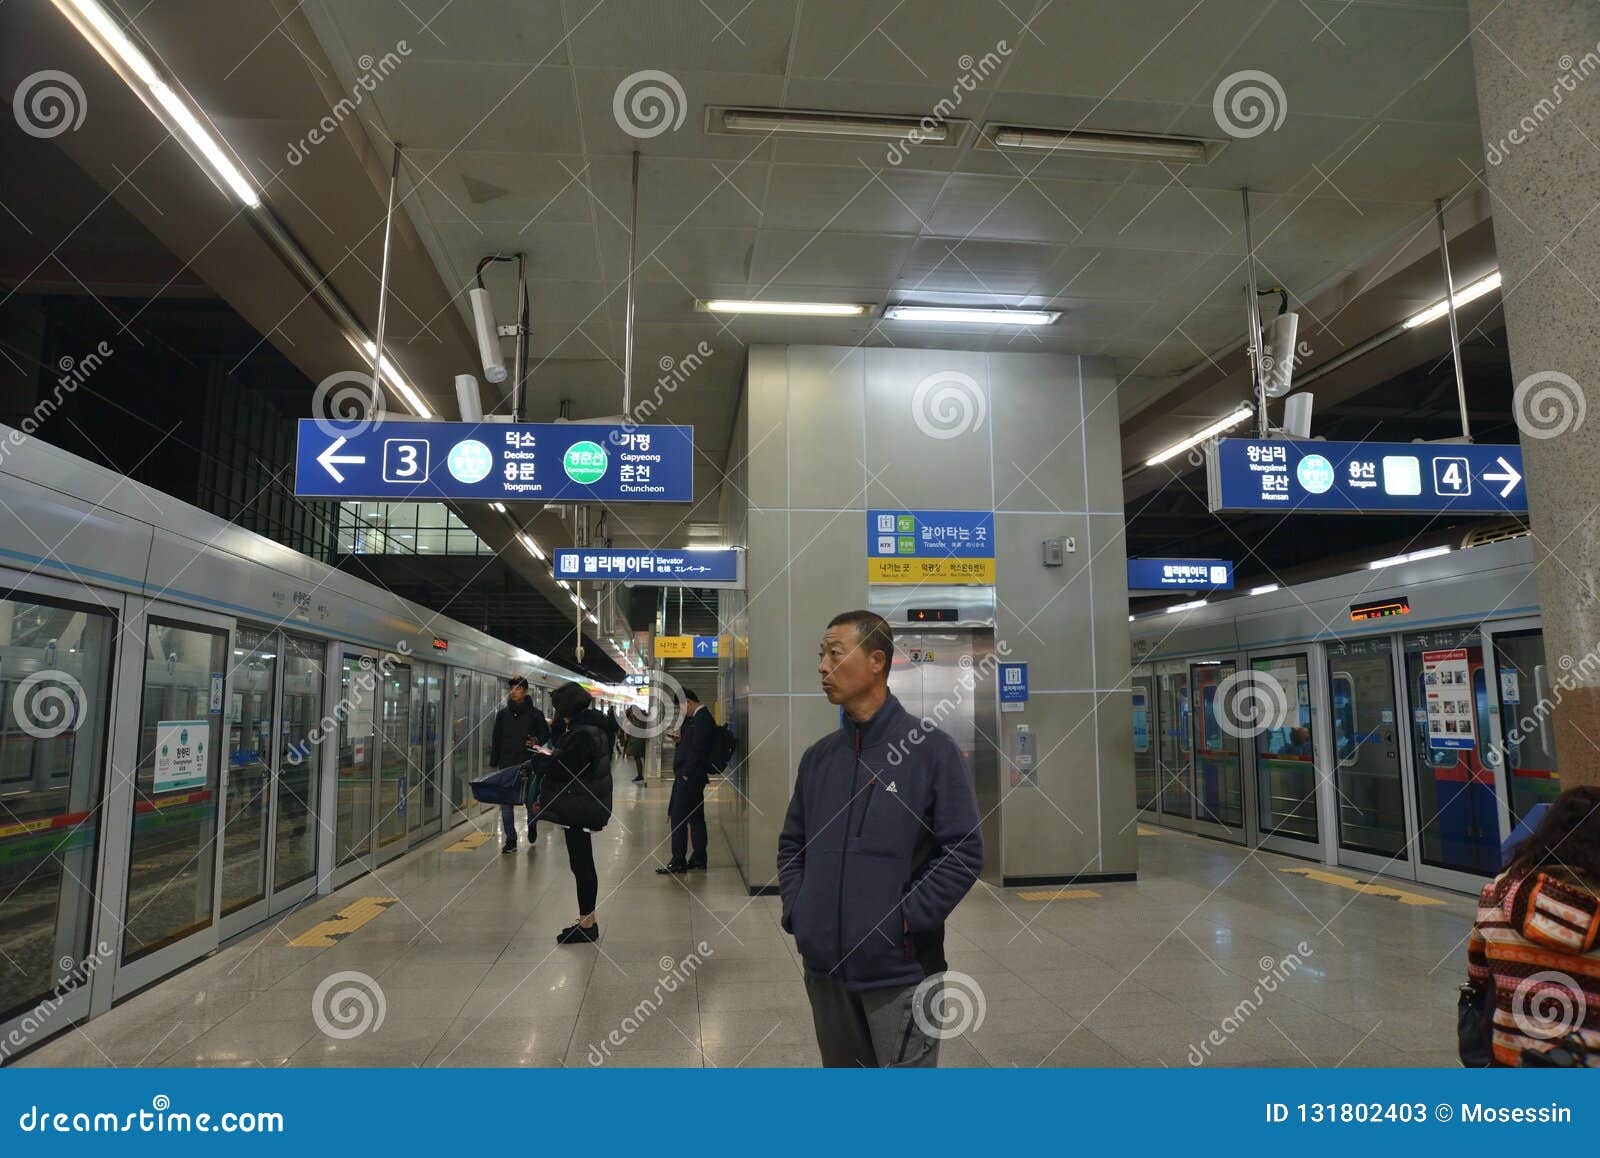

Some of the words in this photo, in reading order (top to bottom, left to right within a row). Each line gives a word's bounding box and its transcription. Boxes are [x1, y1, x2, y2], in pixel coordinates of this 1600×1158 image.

[505, 432, 535, 448] 덕소
[620, 434, 650, 451] 가평
[396, 445, 417, 476] 3
[504, 451, 534, 459] Deokso
[620, 453, 661, 463] Gapyeong
[1247, 446, 1286, 462] 왕십리
[504, 462, 534, 480] 용문
[620, 464, 650, 482] 춘천
[1250, 464, 1287, 473] Wangsimni
[1348, 461, 1375, 478] 용산
[1442, 463, 1462, 490] 4
[504, 483, 542, 492] Yongmun
[620, 484, 665, 493] Chuncheon
[1262, 475, 1289, 491] 문산
[1262, 493, 1289, 501] Munsan
[921, 526, 970, 540] 갈아타는
[975, 527, 987, 540] 곳
[584, 556, 654, 573] 엘리베이터
[656, 557, 684, 565] Elevator
